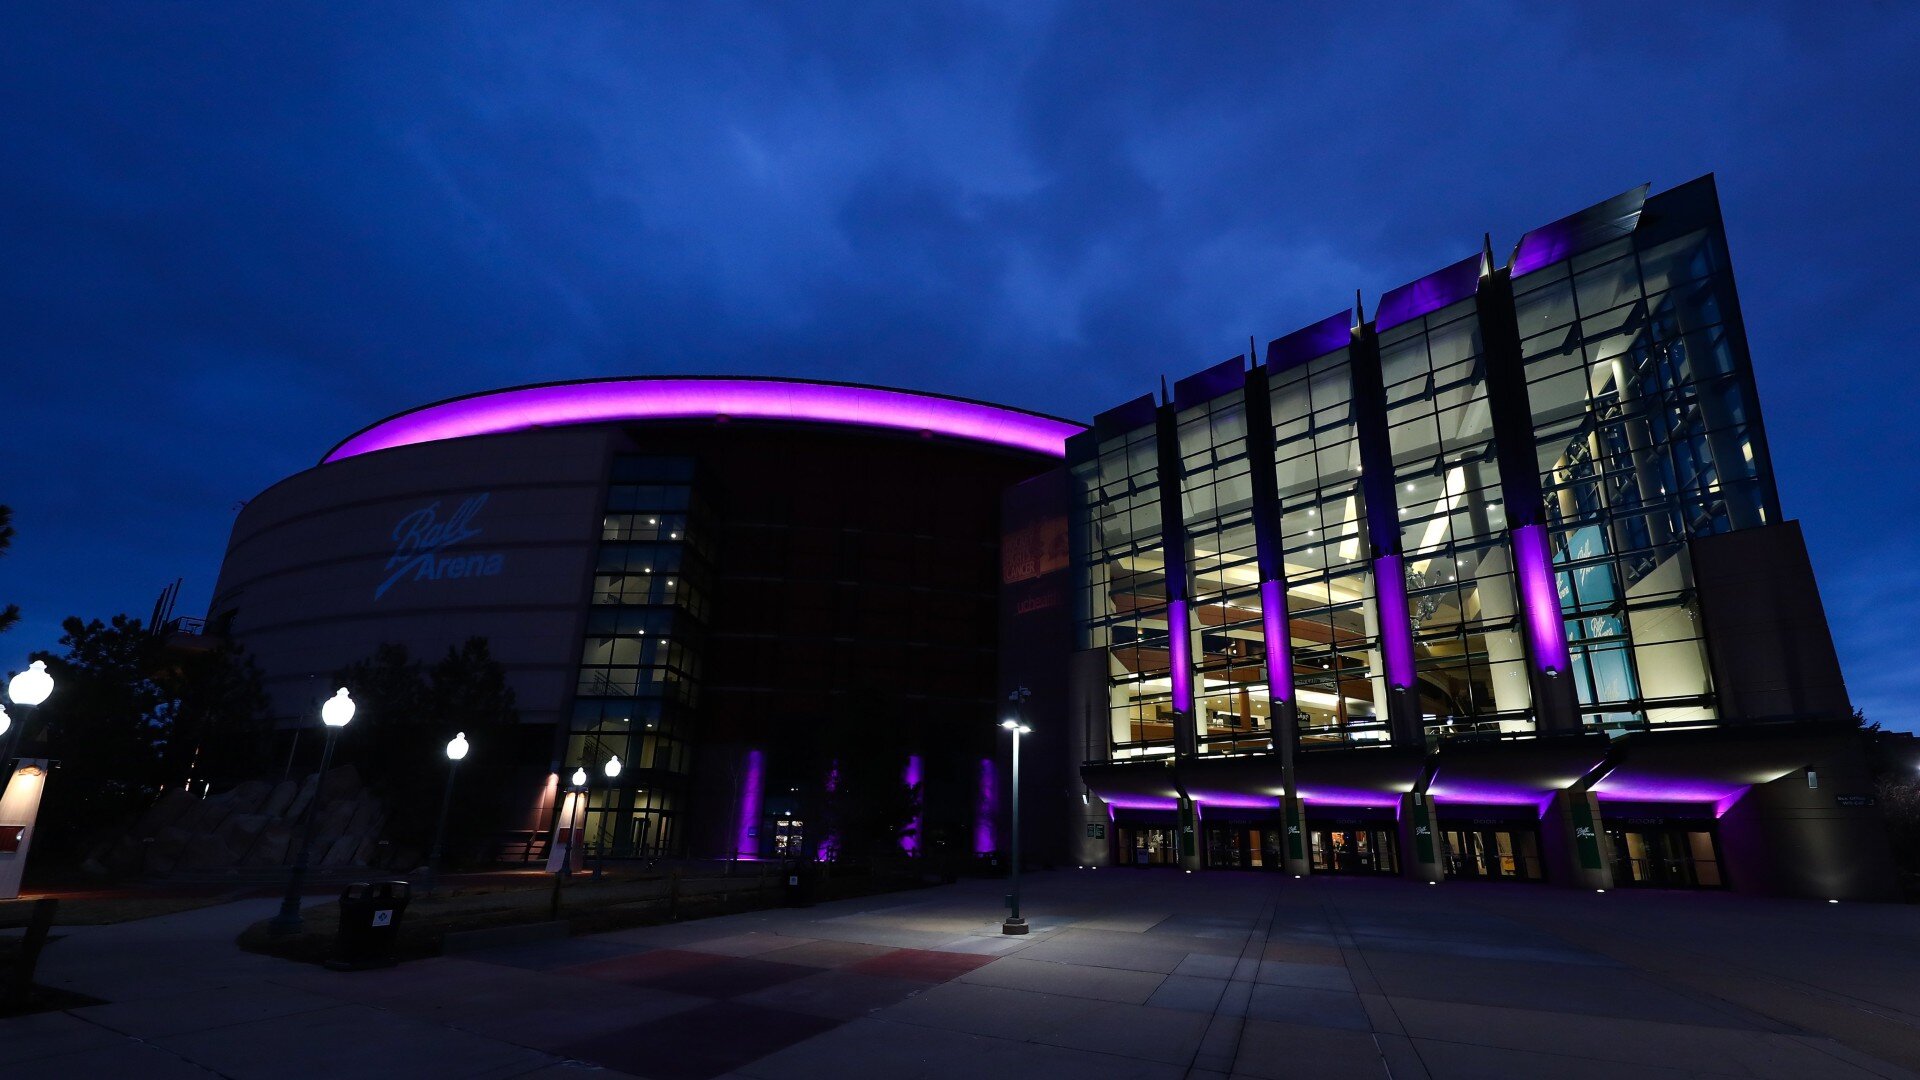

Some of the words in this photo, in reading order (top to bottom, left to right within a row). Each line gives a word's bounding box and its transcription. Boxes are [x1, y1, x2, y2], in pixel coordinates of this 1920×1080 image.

[384, 492, 491, 571] Ball
[413, 553, 505, 582] Arena
[1006, 560, 1035, 579] CANCER
